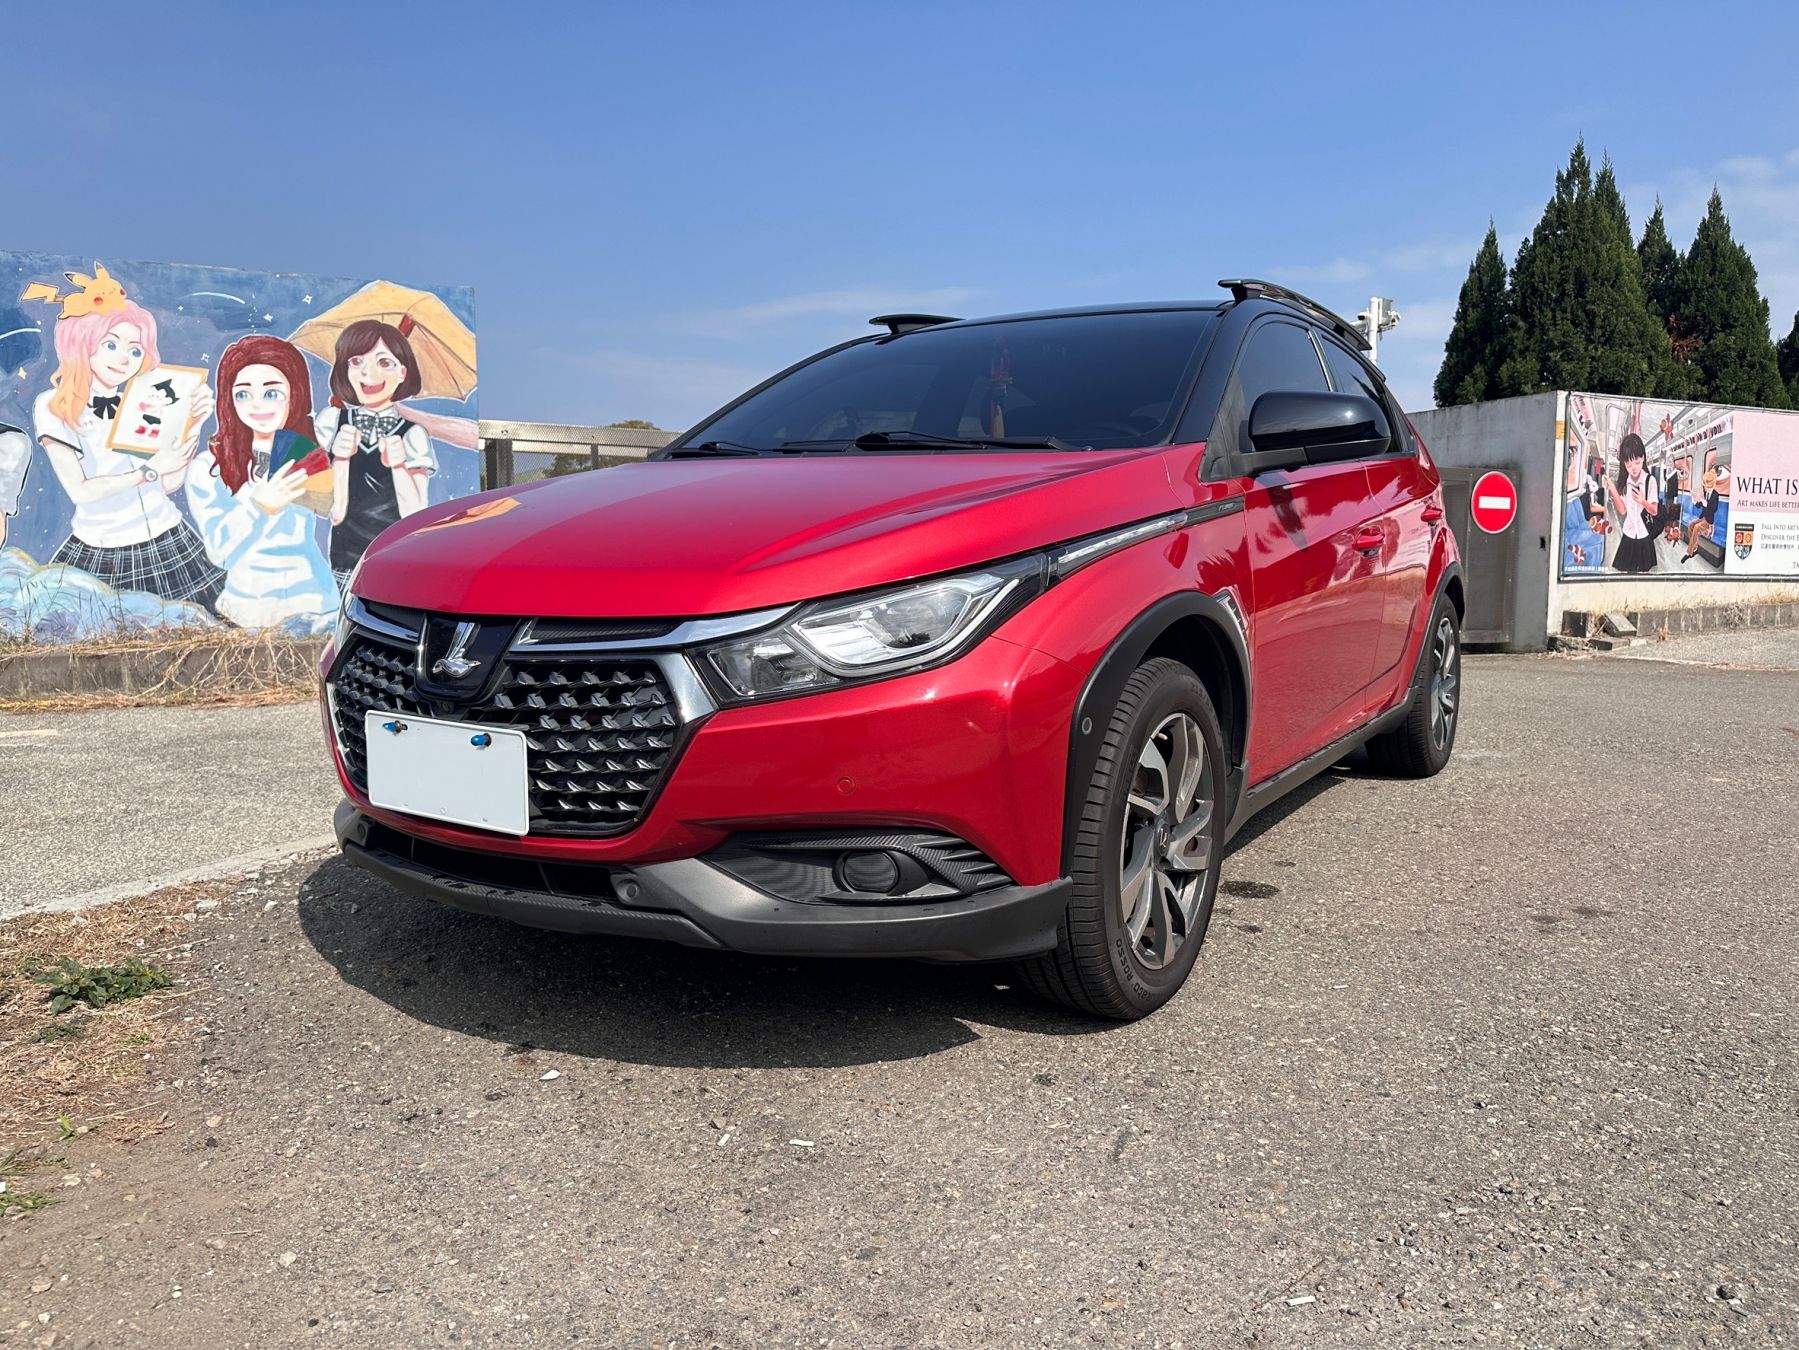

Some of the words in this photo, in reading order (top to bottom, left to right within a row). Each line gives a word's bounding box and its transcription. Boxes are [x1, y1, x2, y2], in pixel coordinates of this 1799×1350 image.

[1736, 476, 1782, 495] WHAT
[1786, 478, 1799, 496] IS
[1737, 499, 1749, 507] ART
[1116, 938, 1134, 981] ROSSO
